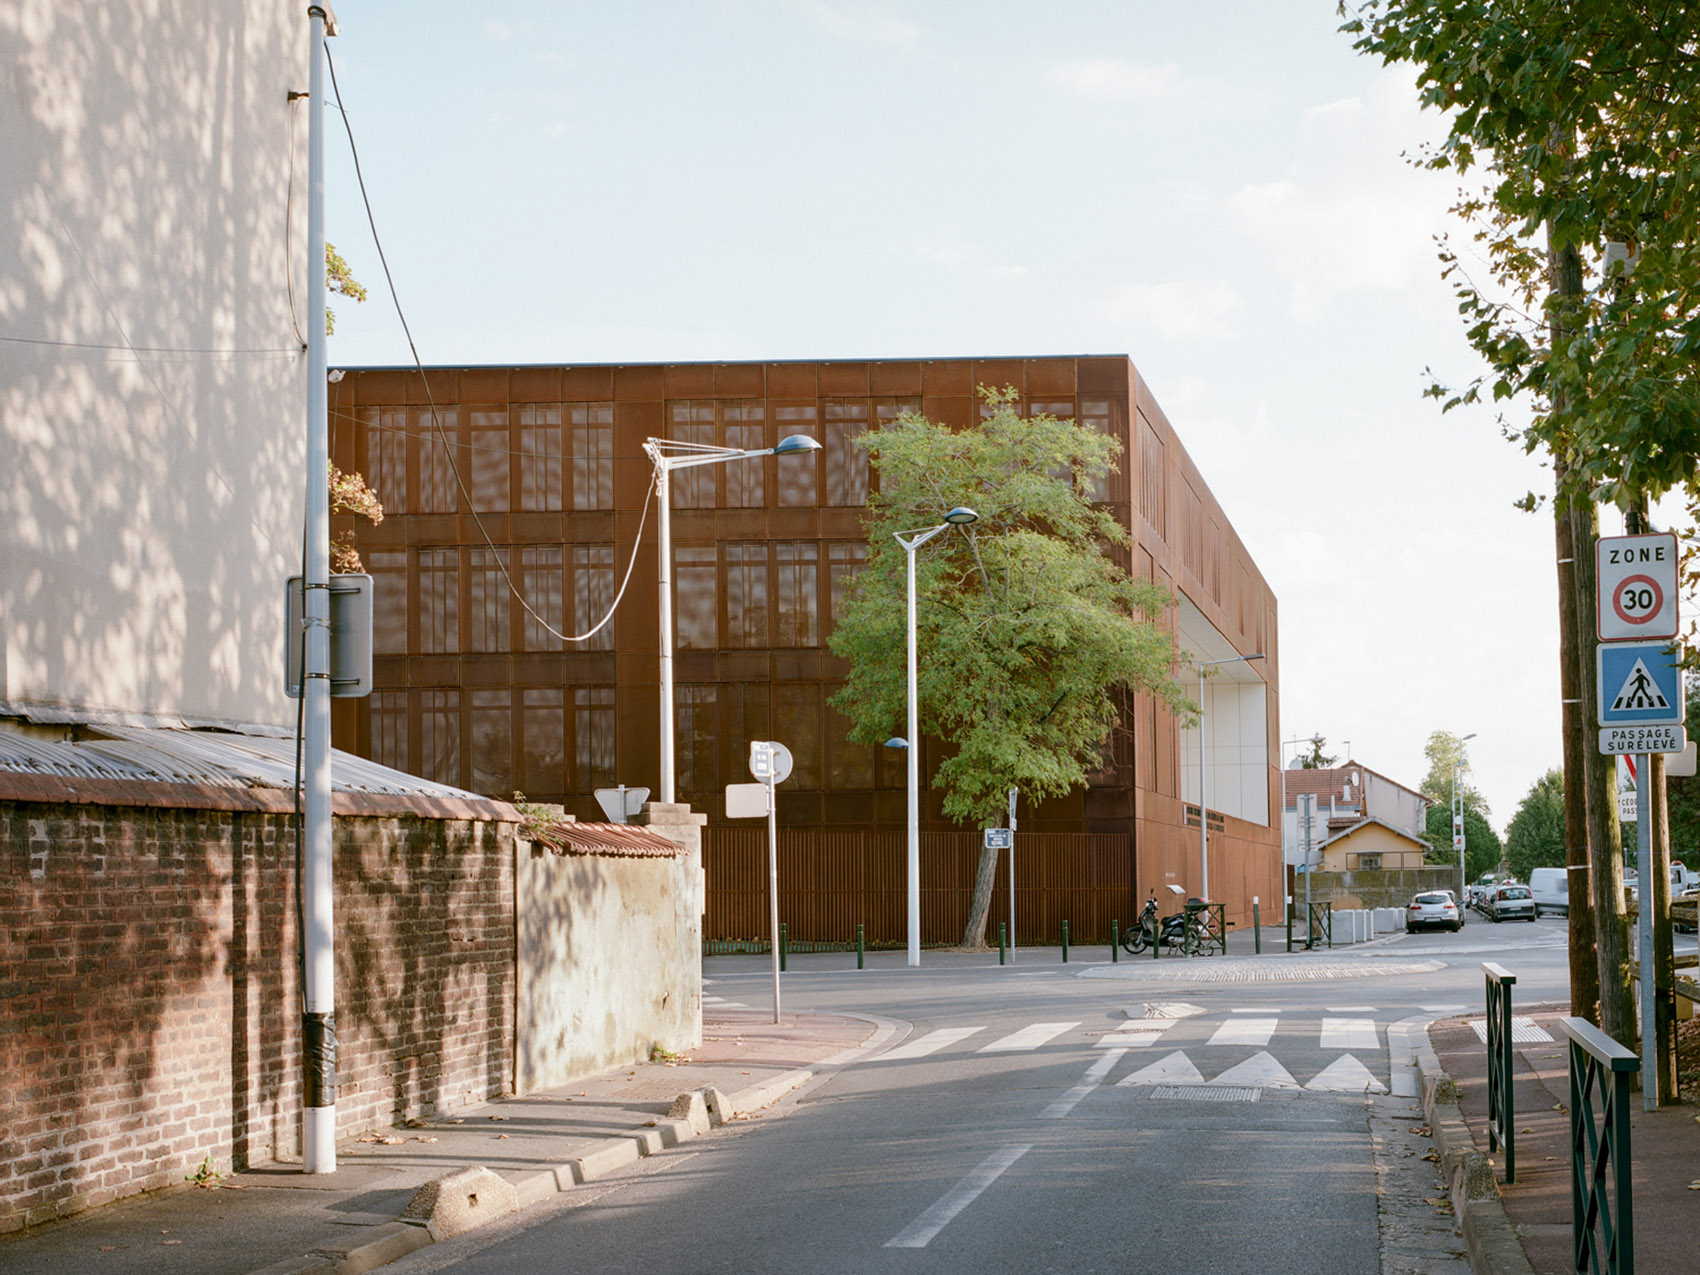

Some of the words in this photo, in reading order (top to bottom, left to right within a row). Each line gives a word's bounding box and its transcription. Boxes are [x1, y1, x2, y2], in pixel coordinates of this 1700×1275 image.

[1609, 546, 1665, 564] ZONE
[1624, 589, 1652, 610] 30
[1612, 728, 1671, 740] PASSAGE
[1607, 737, 1676, 751] SURÉLEVÉ
